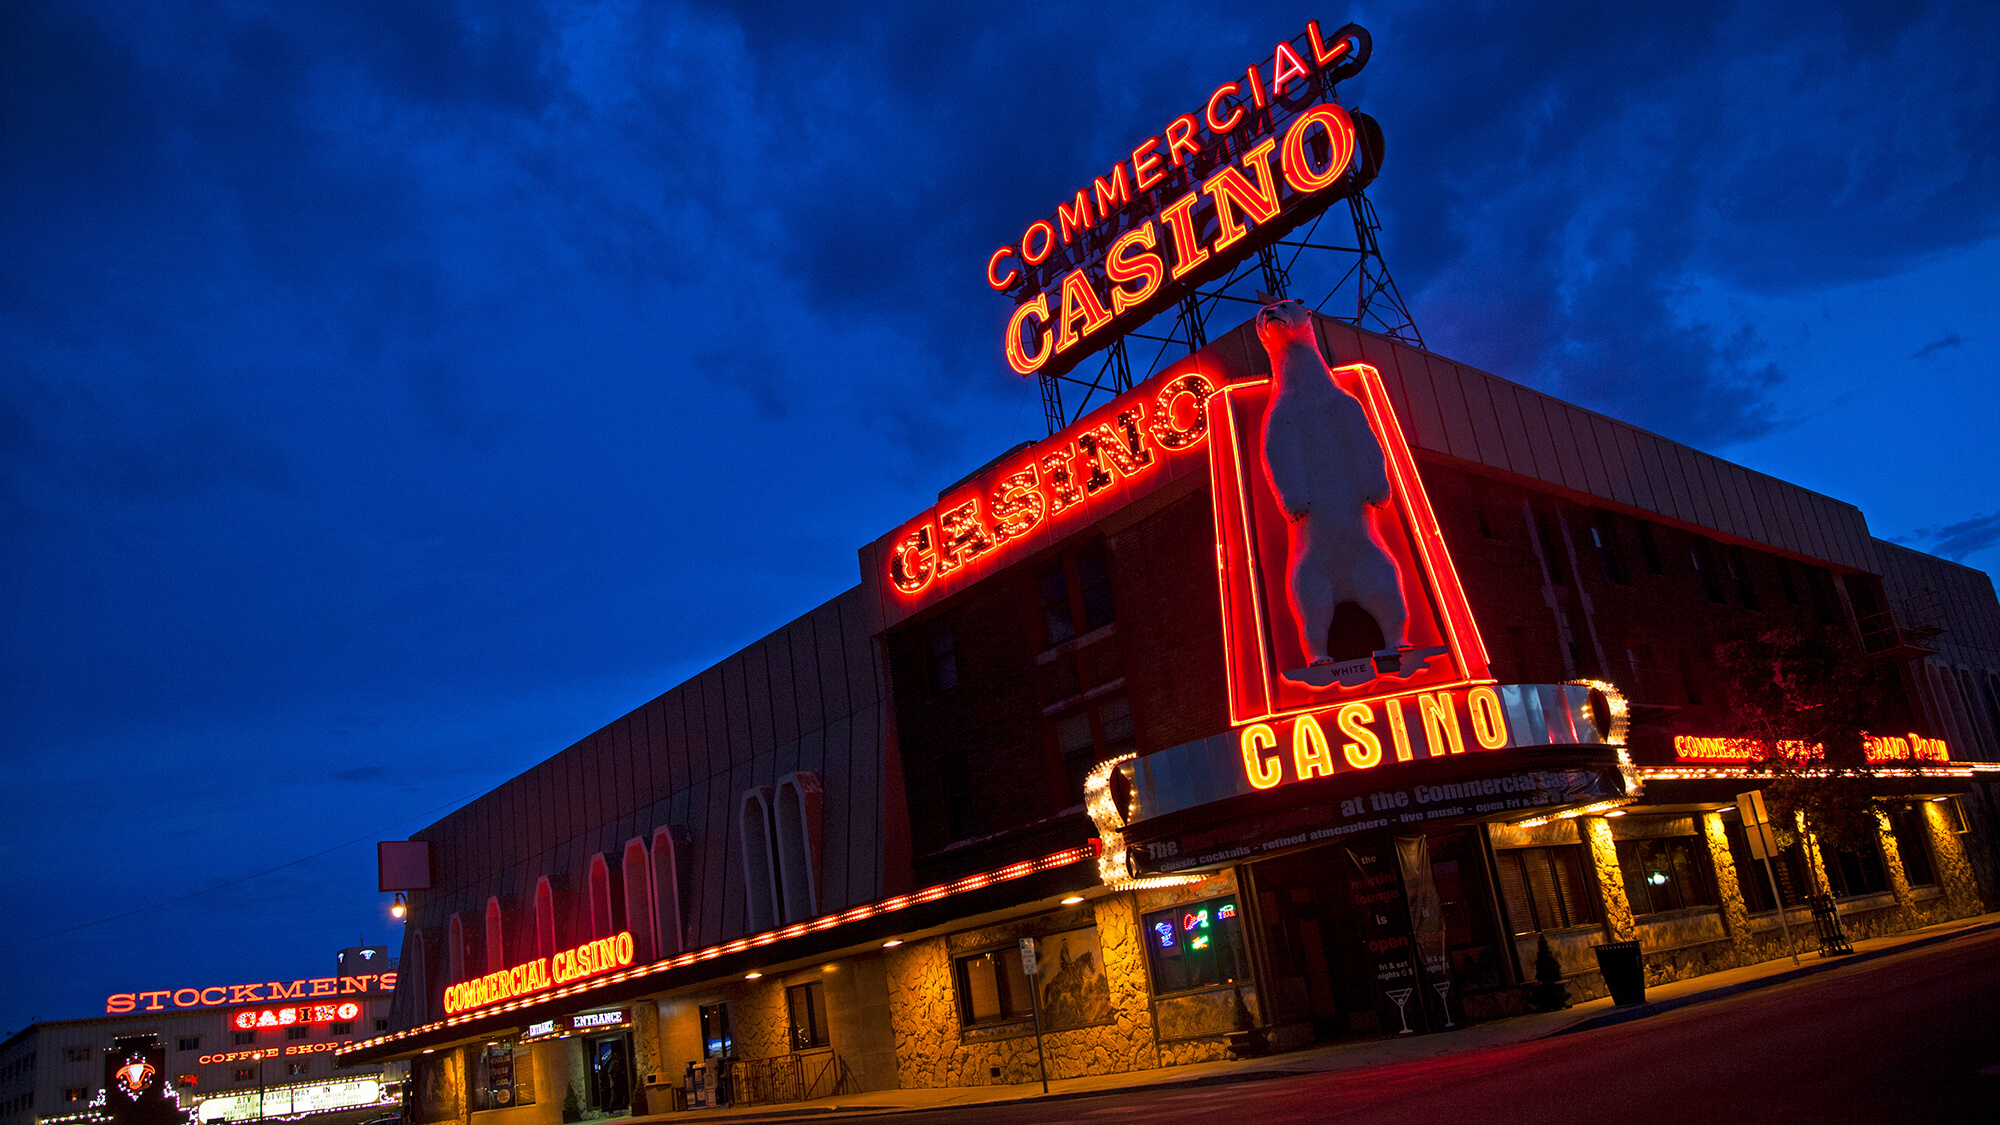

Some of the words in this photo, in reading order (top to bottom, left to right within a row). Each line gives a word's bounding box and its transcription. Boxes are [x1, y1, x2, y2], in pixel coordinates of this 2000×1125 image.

[986, 18, 1353, 291] COMMERCIAL
[1005, 102, 1356, 375] CASINO
[889, 372, 1214, 594] CASINO
[1331, 664, 1367, 677] WHITE
[1240, 686, 1509, 790] CASINO
[1674, 735, 1768, 761] COMMERC
[1340, 796, 1365, 817] at
[1370, 789, 1410, 811] the
[1414, 771, 1537, 805] Commercial
[1160, 857, 1197, 874] classic
[1199, 846, 1251, 865] cocktails
[1262, 832, 1307, 851] refined
[1309, 815, 1388, 843] atmosphere
[1400, 810, 1424, 825] live
[1425, 803, 1464, 821] music
[1476, 801, 1504, 813] open
[1506, 798, 1519, 809] Fri
[1147, 839, 1179, 861] The
[1361, 853, 1377, 865] the
[1376, 914, 1388, 926] is
[1369, 934, 1409, 955] open
[443, 956, 551, 1014] COMMERCIAL
[551, 931, 634, 984] CASINO
[1377, 970, 1400, 981] nights
[1396, 960, 1409, 969] sat
[106, 972, 397, 1014] STOCKMEN'S
[235, 1002, 359, 1029] CASINO
[573, 1011, 623, 1028] ENTRANCE
[285, 1041, 339, 1056] SHOP
[344, 1082, 361, 1092] JULY
